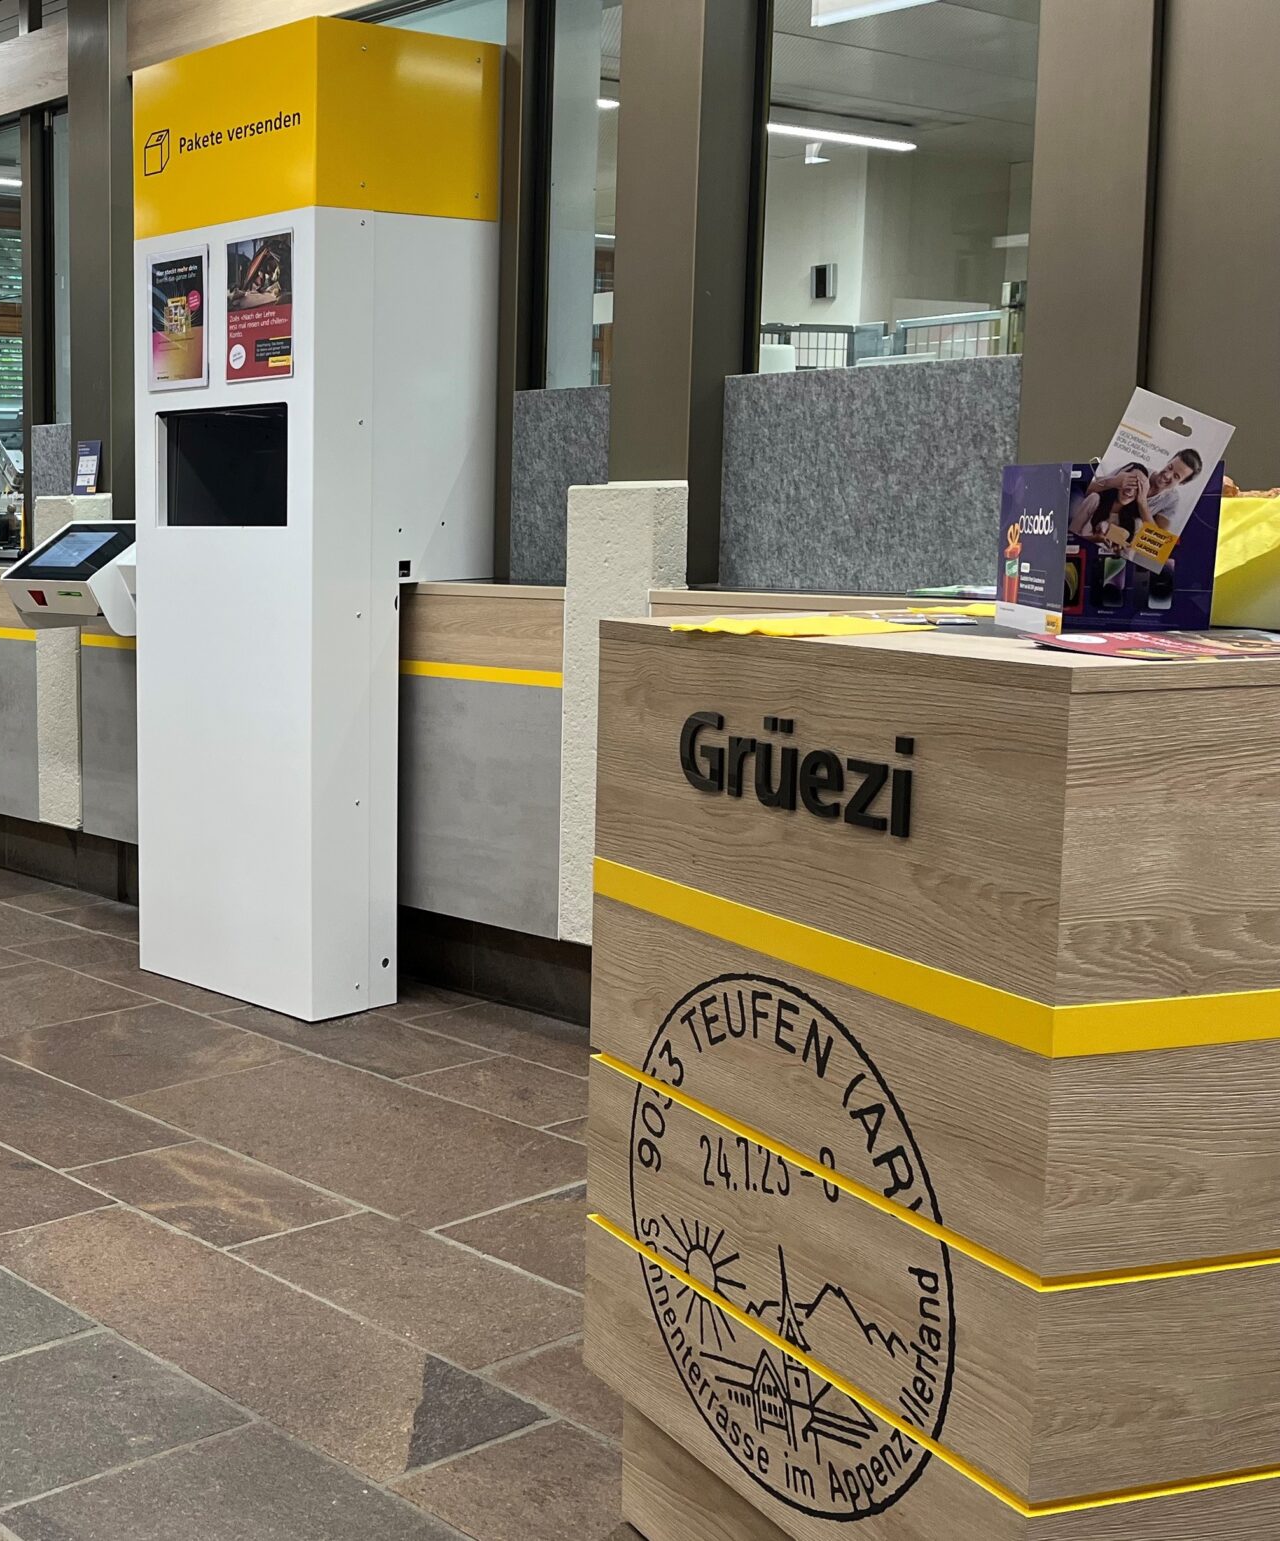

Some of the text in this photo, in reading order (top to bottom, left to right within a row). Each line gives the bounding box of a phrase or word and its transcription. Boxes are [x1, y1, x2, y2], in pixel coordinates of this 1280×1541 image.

[179, 111, 301, 154] Pakete versenden
[679, 711, 915, 838] Grüezi
[637, 1039, 685, 1173] 9053
[680, 990, 834, 1079] TEUFEN
[783, 1451, 816, 1500] im
